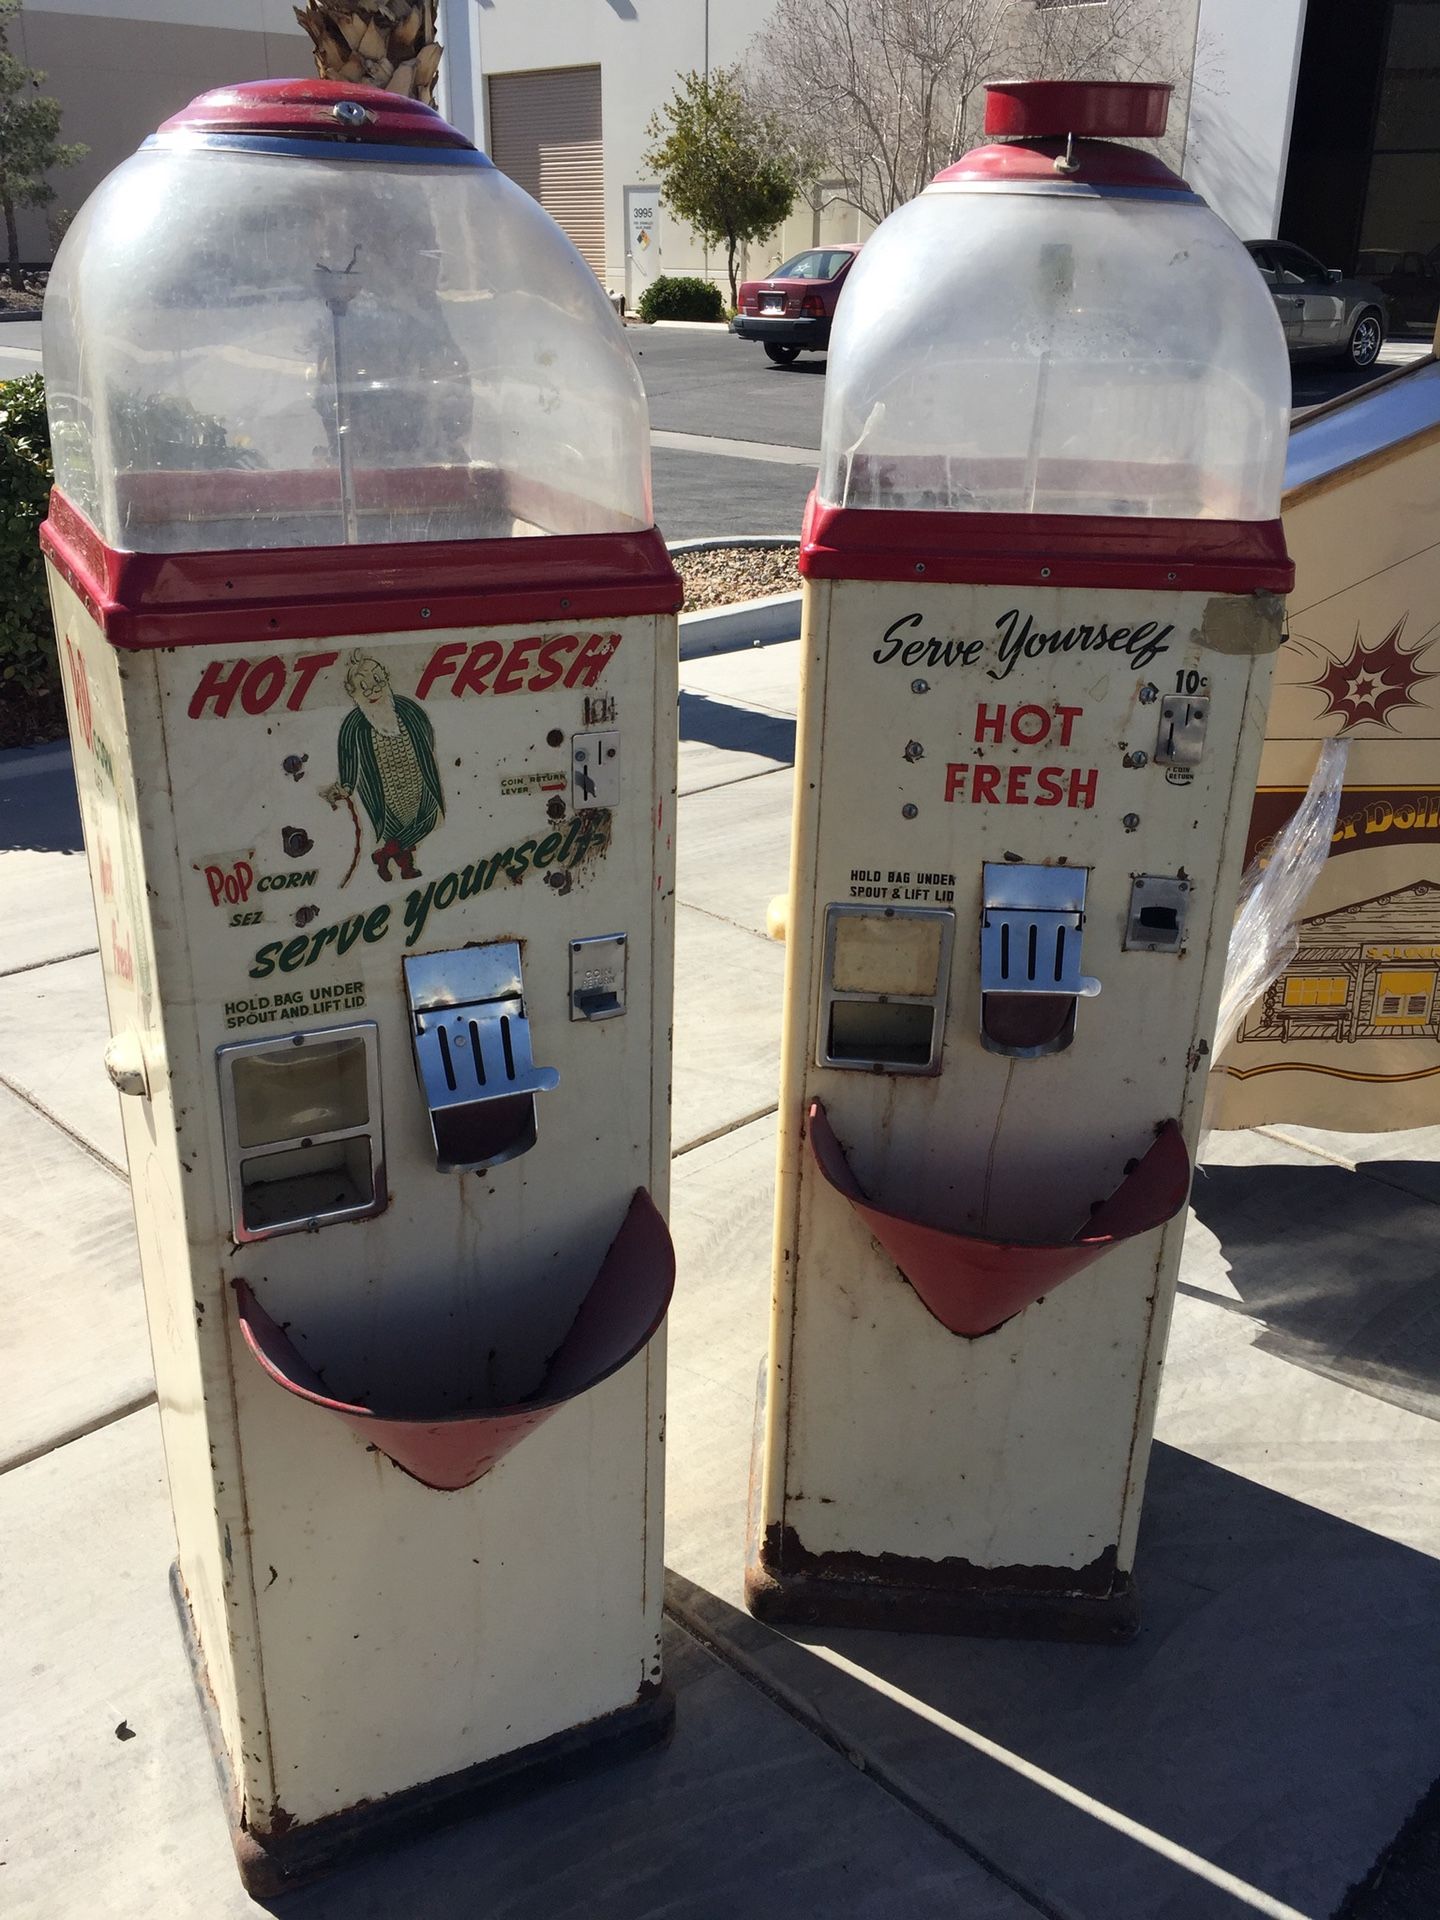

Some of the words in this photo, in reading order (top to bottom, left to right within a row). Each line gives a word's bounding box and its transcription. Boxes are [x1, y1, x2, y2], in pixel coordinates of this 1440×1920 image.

[633, 207, 653, 218] 3995
[873, 612, 984, 667] Serve
[986, 608, 1176, 680] Yourself
[414, 633, 623, 700] FRESH
[187, 651, 340, 720] HOT
[974, 703, 1083, 746] HOT
[500, 777, 524, 787] COIN
[529, 773, 567, 783] RETURN
[501, 786, 529, 796] LEVER
[944, 763, 1098, 809] FRESH
[1363, 795, 1440, 834] Doll
[256, 870, 317, 893] CORN
[850, 869, 881, 882] HOLD
[887, 871, 911, 884] BAG
[916, 872, 957, 886] UNDER
[850, 885, 889, 898] SPOUT
[891, 887, 901, 900] &
[904, 888, 930, 901] LIFT
[934, 890, 955, 902] LID
[249, 903, 392, 979] serve
[402, 811, 608, 947] yourself
[229, 911, 264, 928] SEZ
[224, 997, 270, 1016] HOLD
[273, 991, 304, 1007] BAG
[309, 981, 364, 1001] UNDER
[226, 1010, 278, 1029] SPOUT
[280, 1005, 310, 1020] AND
[313, 999, 342, 1014] LIFT
[344, 995, 366, 1010] LID
